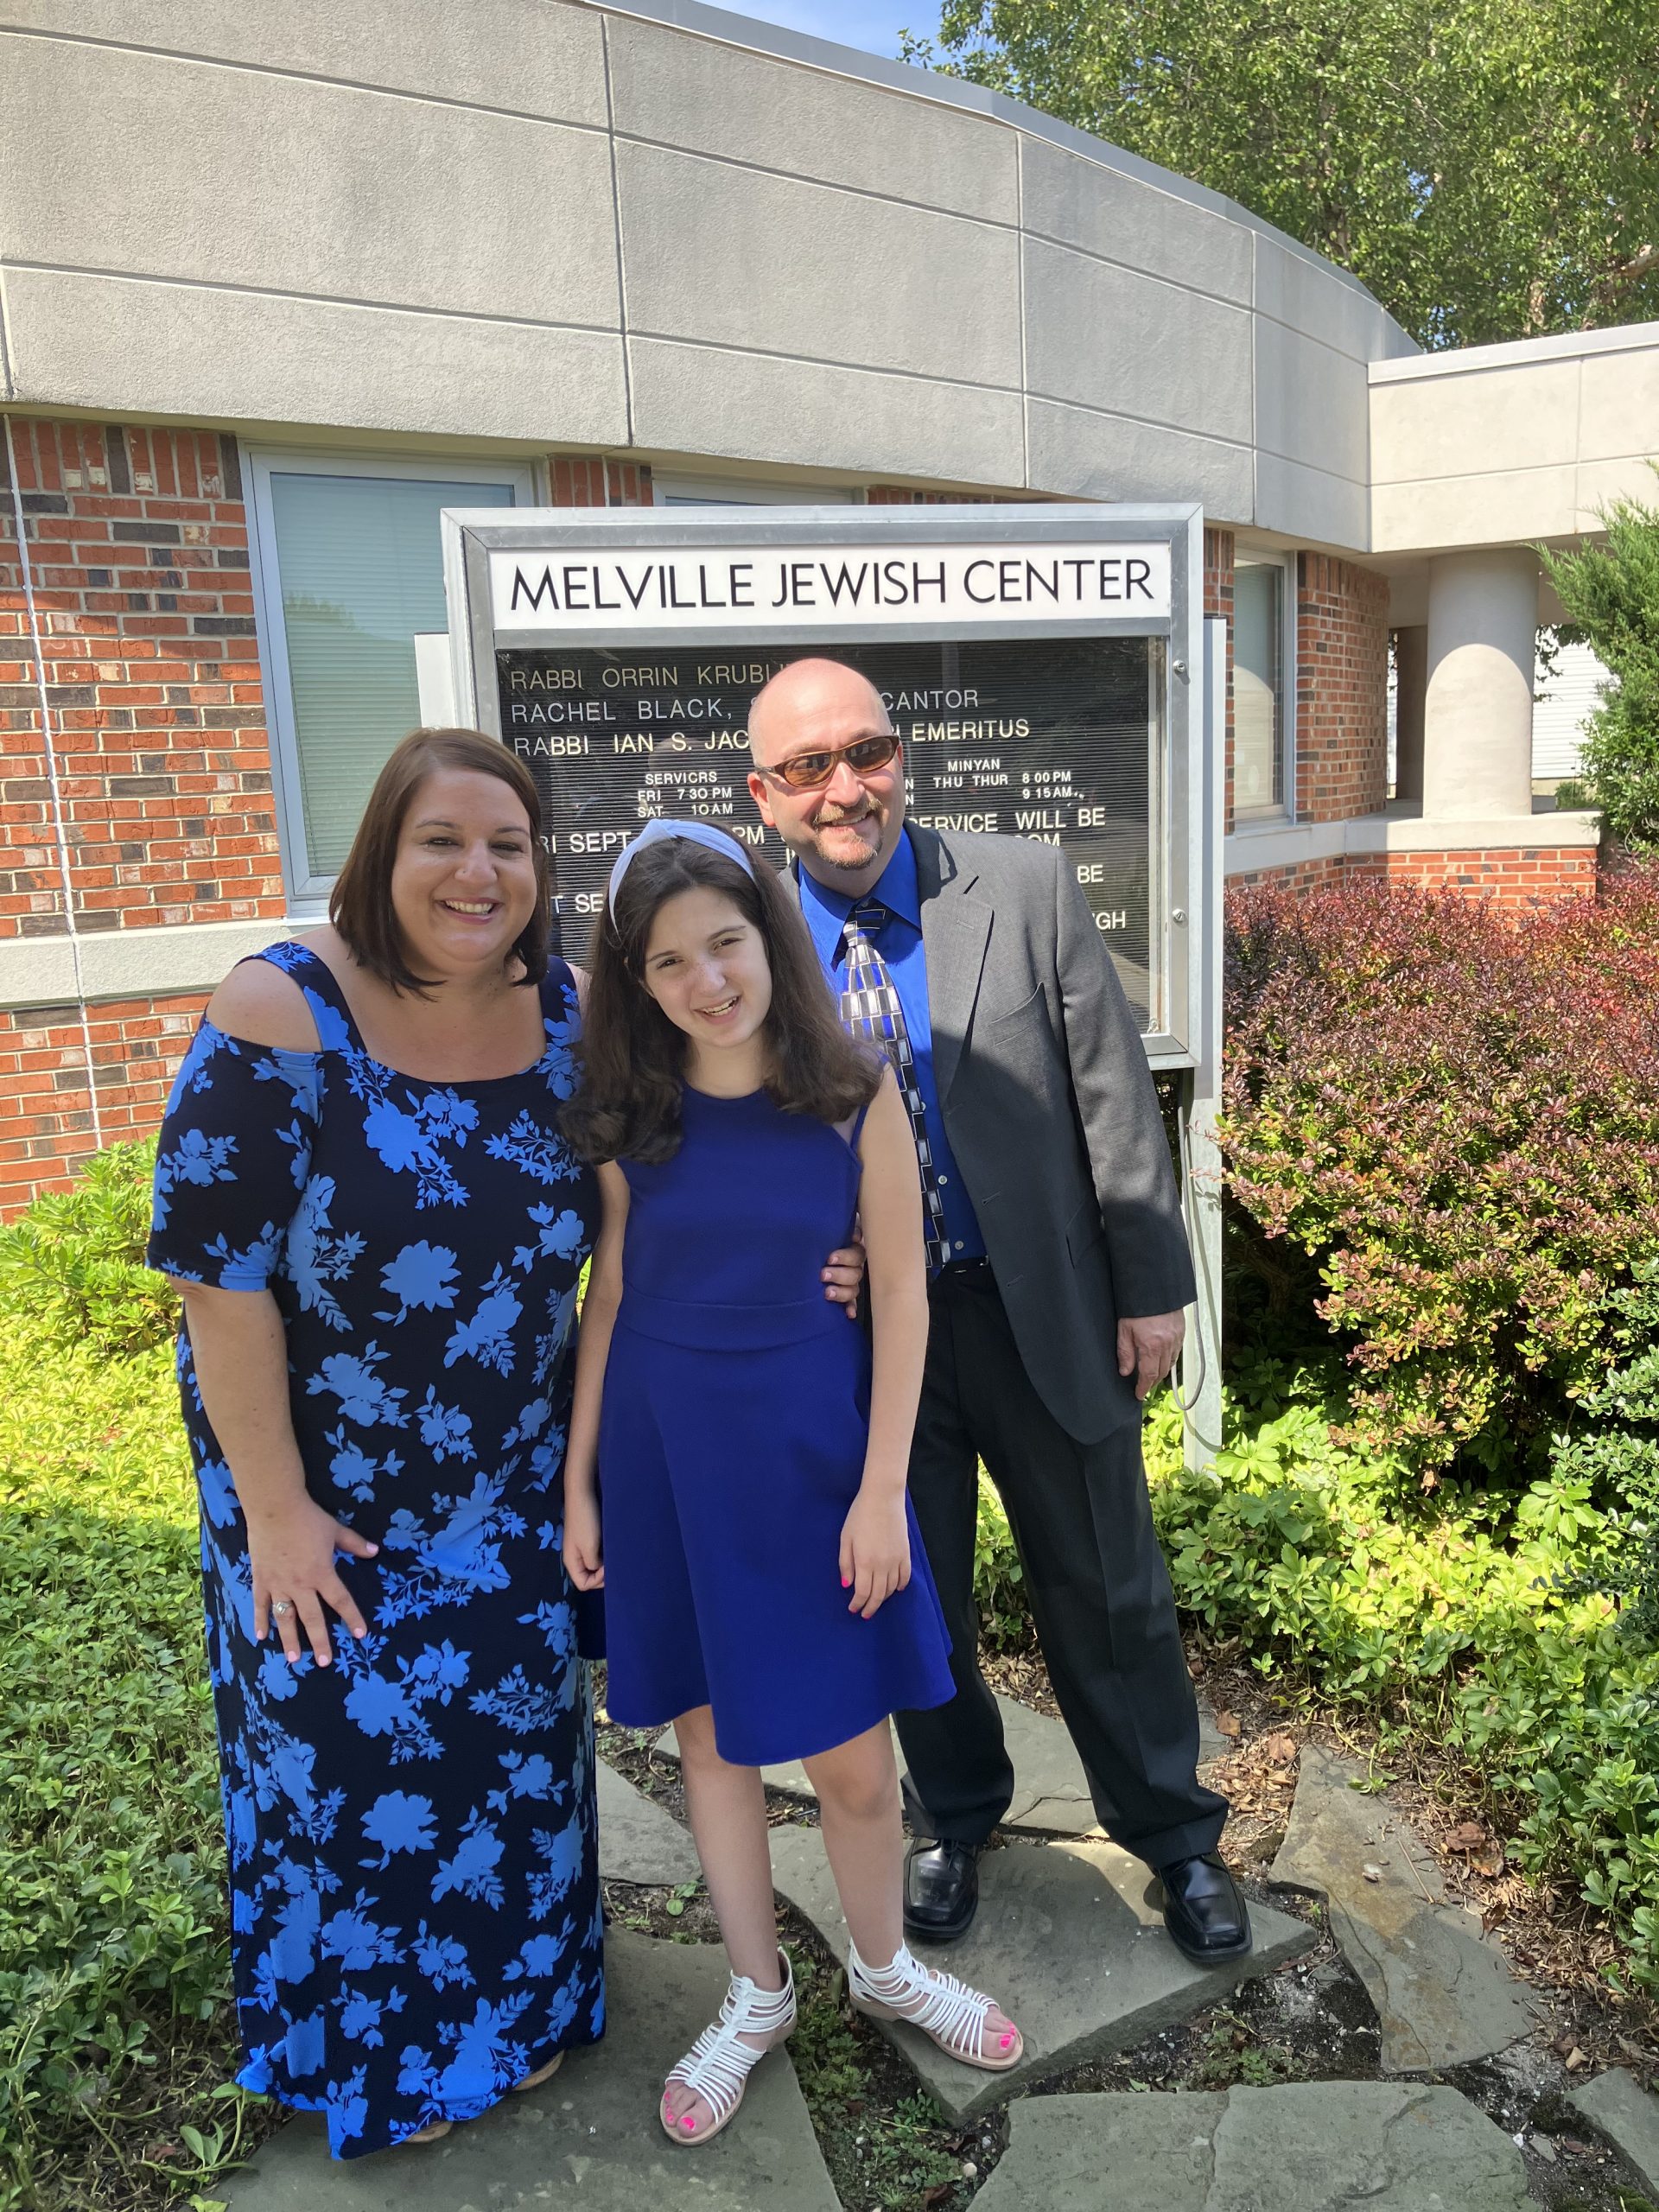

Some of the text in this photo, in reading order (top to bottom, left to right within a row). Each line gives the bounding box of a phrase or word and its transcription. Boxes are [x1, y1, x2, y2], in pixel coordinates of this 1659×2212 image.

[511, 559, 1154, 611] MELVILLE JEWISH CENTER
[511, 669, 583, 690] RABBI
[602, 667, 677, 688] ORRIN
[512, 702, 616, 723] RACHEL
[638, 698, 732, 720] BLACK,
[912, 719, 1030, 742] EMERITUS
[514, 735, 589, 756] RABBI
[613, 734, 653, 753] IAN
[671, 732, 693, 751] S.
[948, 759, 1000, 772] MINYAN
[933, 776, 963, 788] THU
[972, 774, 1008, 786] THUR
[638, 805, 664, 818] SAT
[1014, 810, 1067, 830] WILL
[1077, 807, 1106, 827] BE
[569, 831, 632, 854] SEPT
[1077, 864, 1104, 884] BE
